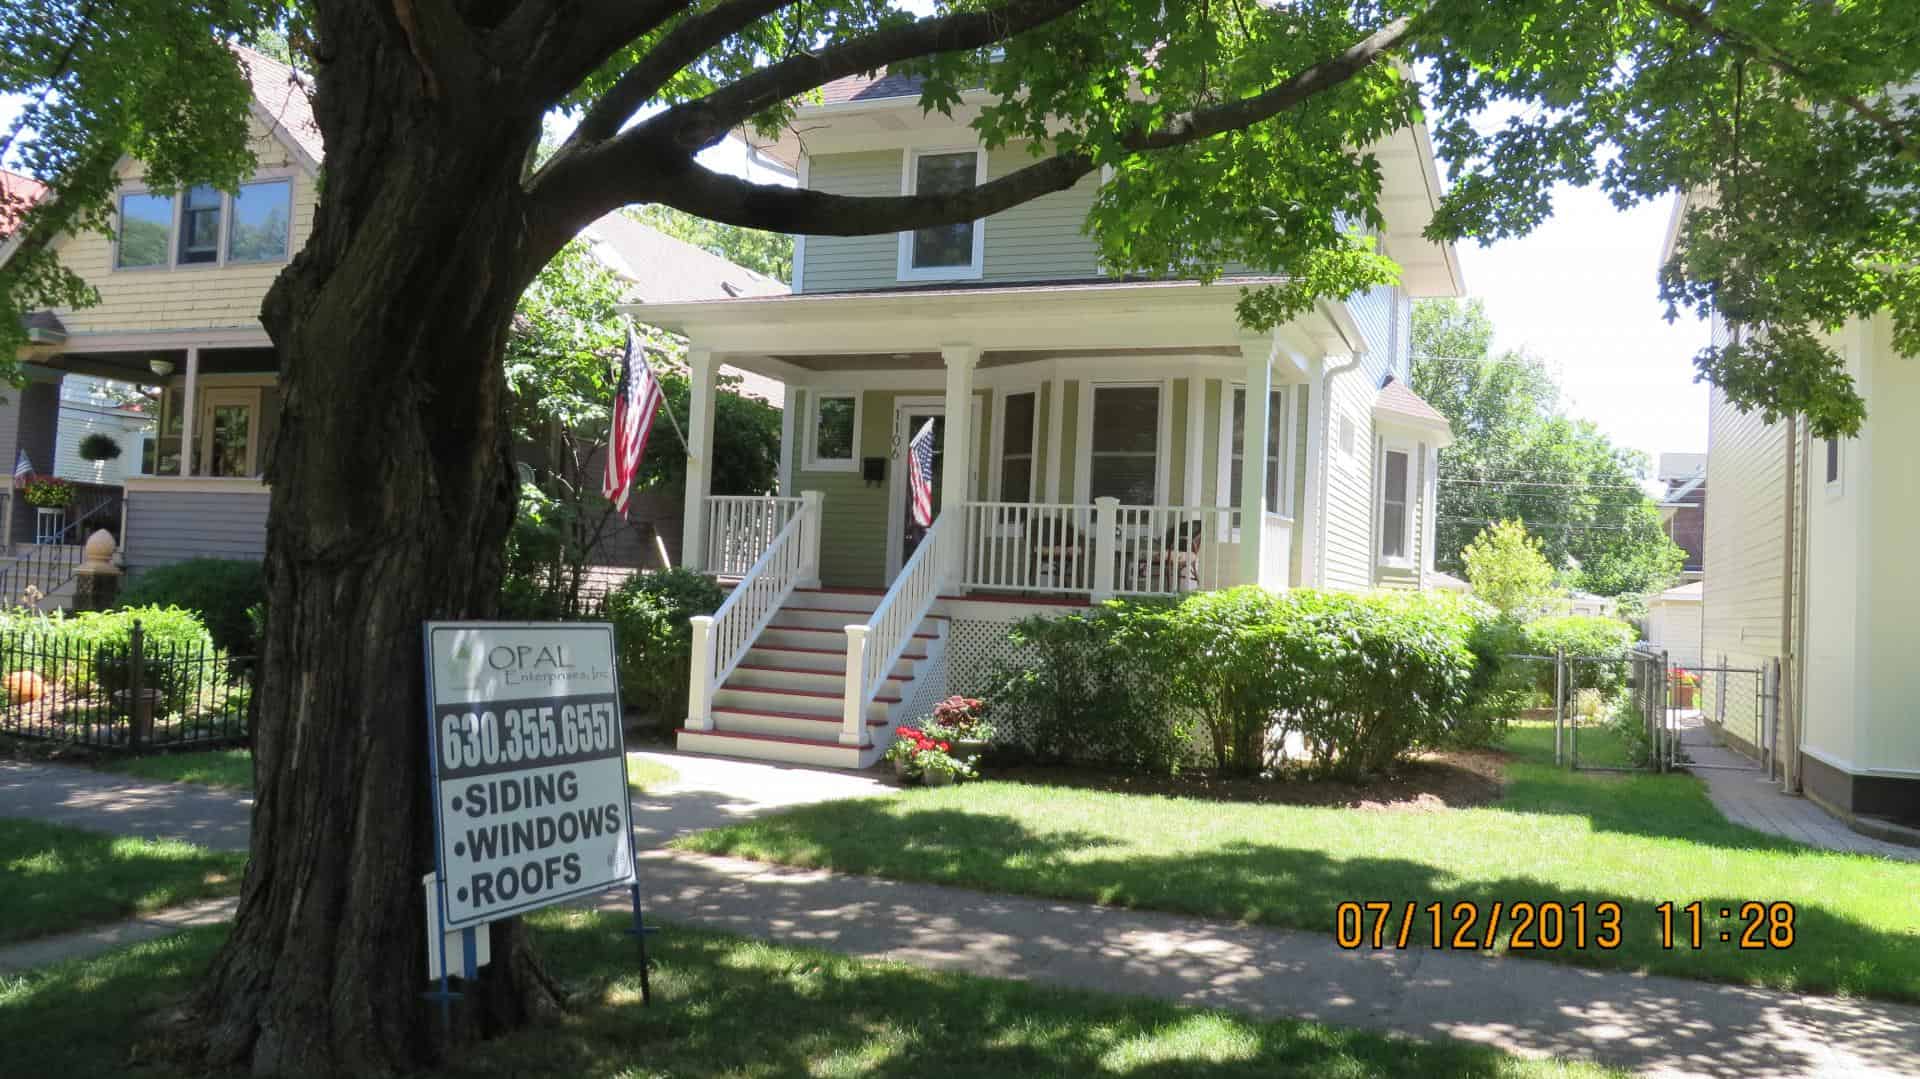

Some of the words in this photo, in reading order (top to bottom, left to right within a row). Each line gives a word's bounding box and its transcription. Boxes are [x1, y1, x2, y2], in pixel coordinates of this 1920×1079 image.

[488, 645, 576, 670] OPAL
[441, 702, 615, 769] 630.355.6557
[465, 770, 578, 818] SIDING
[467, 803, 620, 862] WINDOWS
[471, 852, 581, 907] ROOFS
